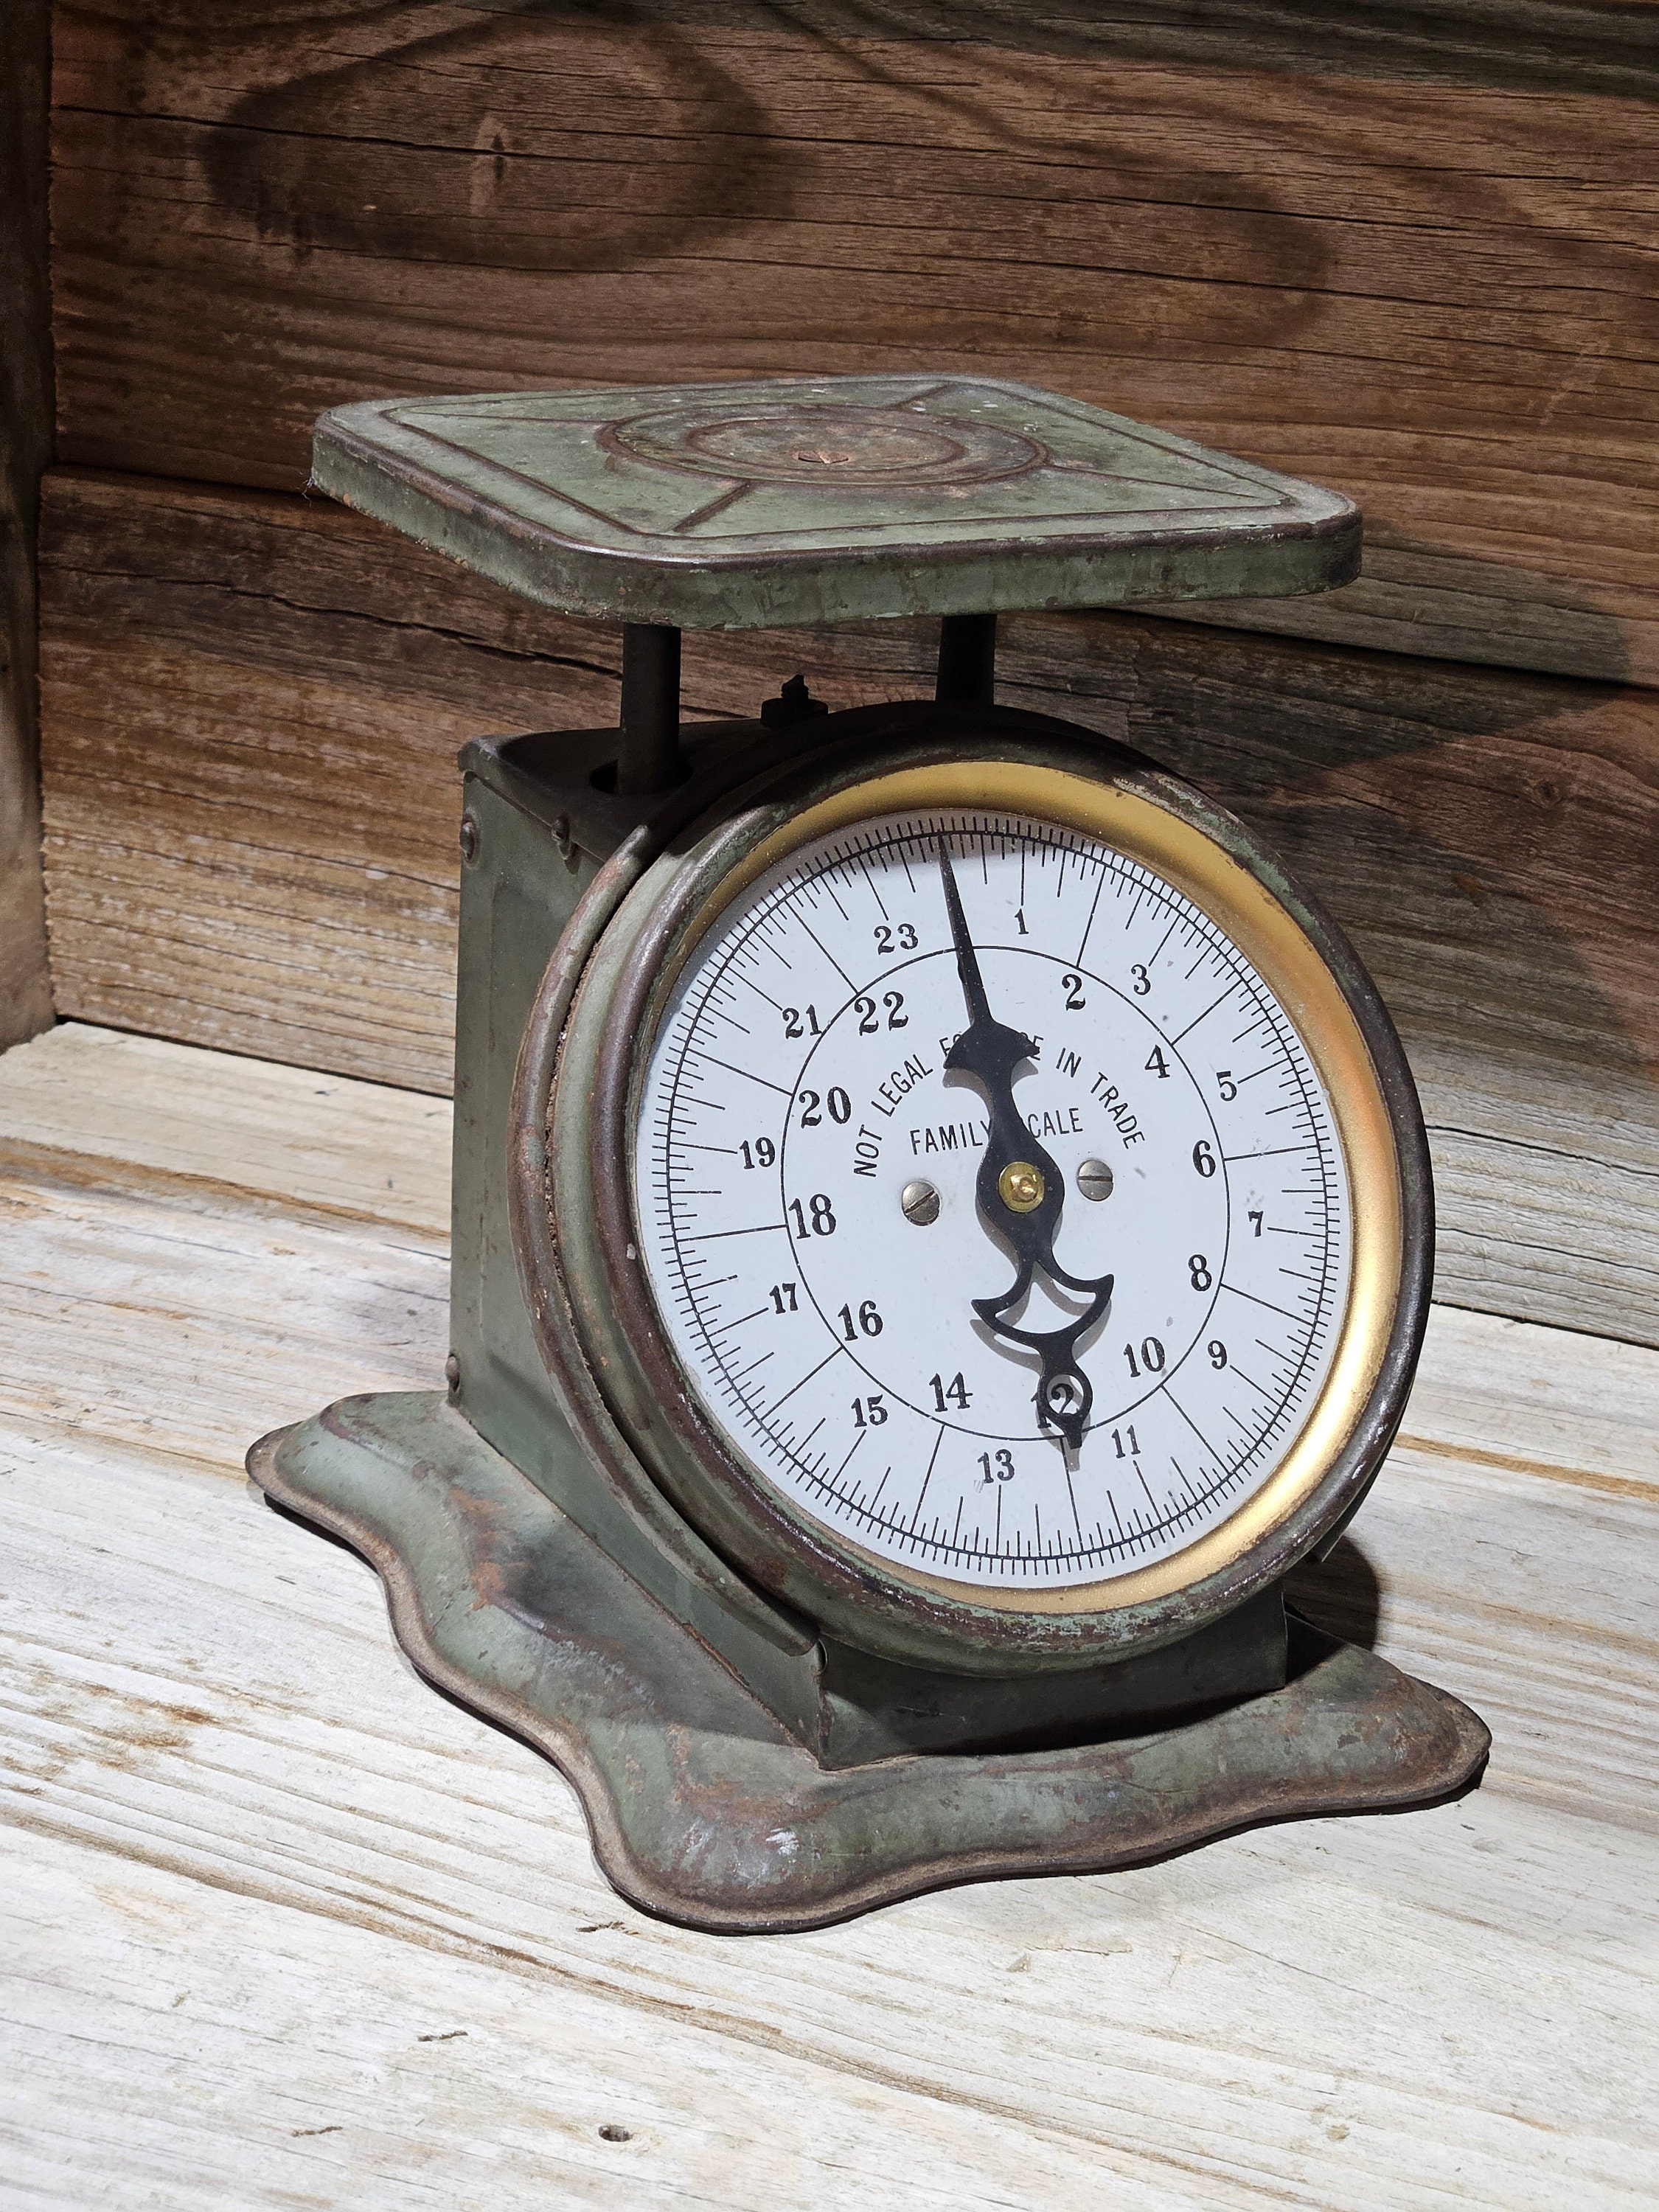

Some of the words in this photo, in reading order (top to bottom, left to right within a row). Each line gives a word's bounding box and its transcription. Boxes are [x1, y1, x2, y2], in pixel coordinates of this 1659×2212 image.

[1014, 908, 1029, 935] 1
[873, 924, 919, 956] 23
[1061, 974, 1086, 1011] 2
[1130, 964, 1152, 995] 3
[782, 1004, 822, 1040] 21
[854, 991, 909, 1036] 22
[1144, 1045, 1171, 1079] 4
[1217, 1071, 1237, 1102] 5
[799, 1086, 852, 1129] 20
[854, 1124, 883, 1178] NOT
[871, 1054, 933, 1116] LEGAL
[1056, 1048, 1082, 1078] IN
[1090, 1072, 1146, 1150] TRADE
[910, 1120, 992, 1155] FAMILY
[1027, 1107, 1083, 1138] CALE
[739, 1136, 776, 1169] 19
[1192, 1140, 1217, 1178] 6
[788, 1193, 837, 1239] 18
[1248, 1210, 1264, 1237] 7
[1188, 1254, 1212, 1292] 8
[769, 1282, 799, 1315] 17
[838, 1300, 883, 1341] 16
[1123, 1336, 1166, 1377] 10
[1207, 1340, 1228, 1370] 9
[928, 1371, 973, 1413] 14
[852, 1394, 888, 1428] 15
[1111, 1425, 1141, 1459] 11
[978, 1449, 1015, 1484] 13
